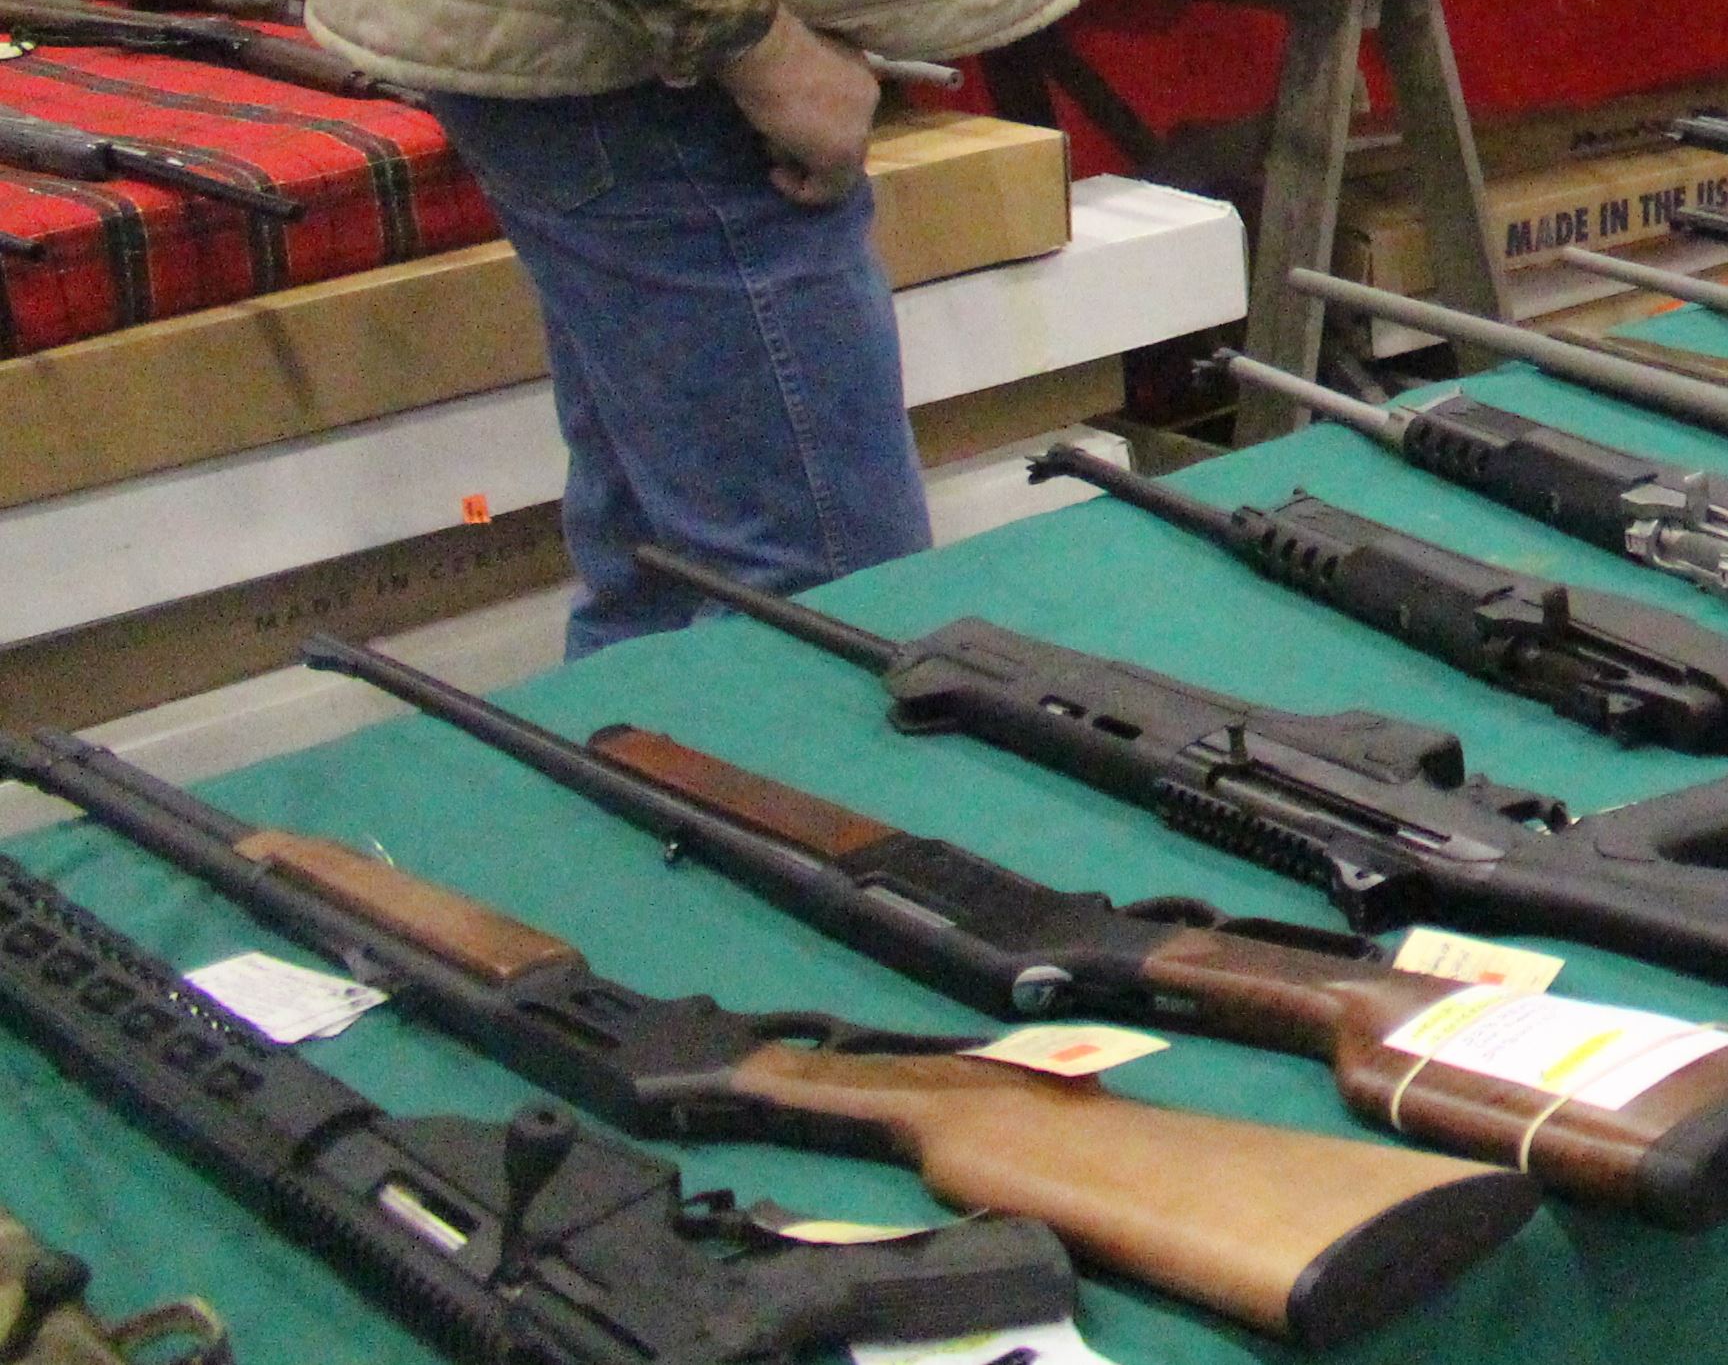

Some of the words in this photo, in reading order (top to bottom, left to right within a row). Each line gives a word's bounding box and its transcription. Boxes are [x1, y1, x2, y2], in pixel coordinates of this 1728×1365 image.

[1505, 206, 1590, 259] MADE
[1600, 197, 1629, 237] IN
[1640, 185, 1686, 229] THE
